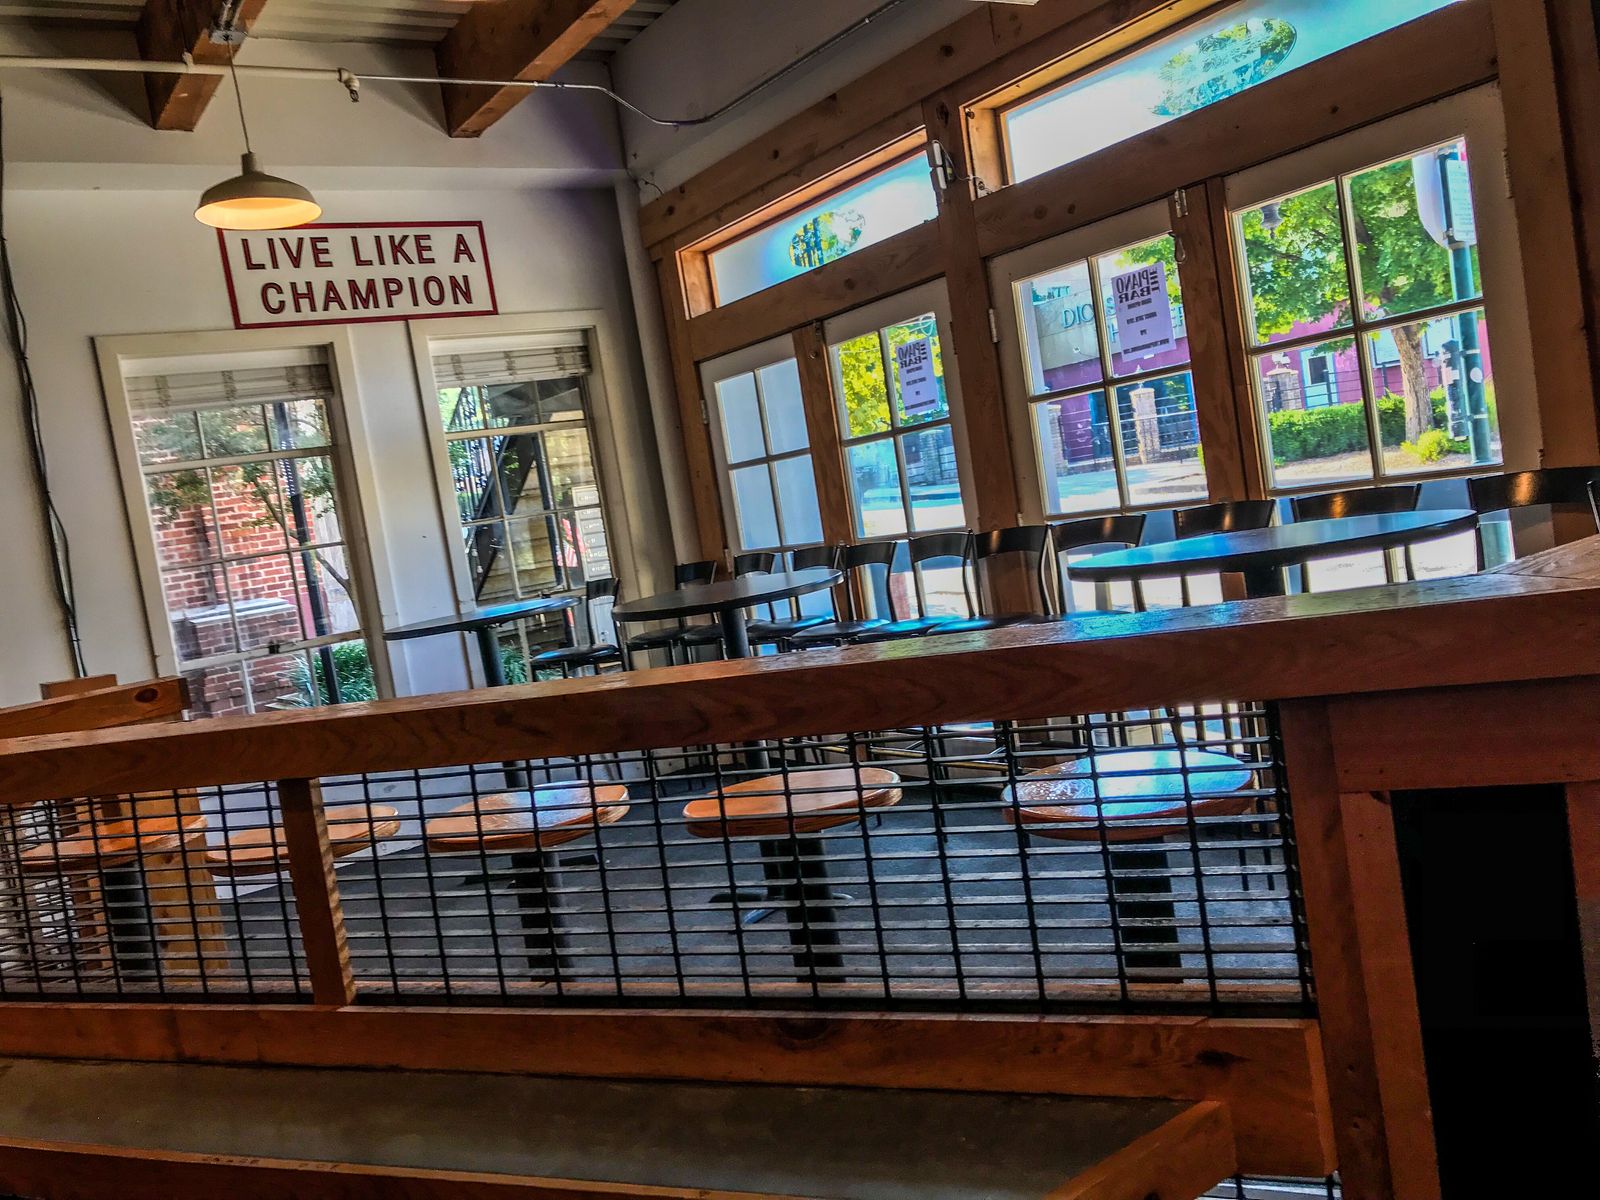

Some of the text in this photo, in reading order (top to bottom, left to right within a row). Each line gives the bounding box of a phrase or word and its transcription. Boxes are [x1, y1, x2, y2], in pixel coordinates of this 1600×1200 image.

[241, 233, 476, 270] LIVE LIKE A
[261, 275, 473, 314] CHAMPION
